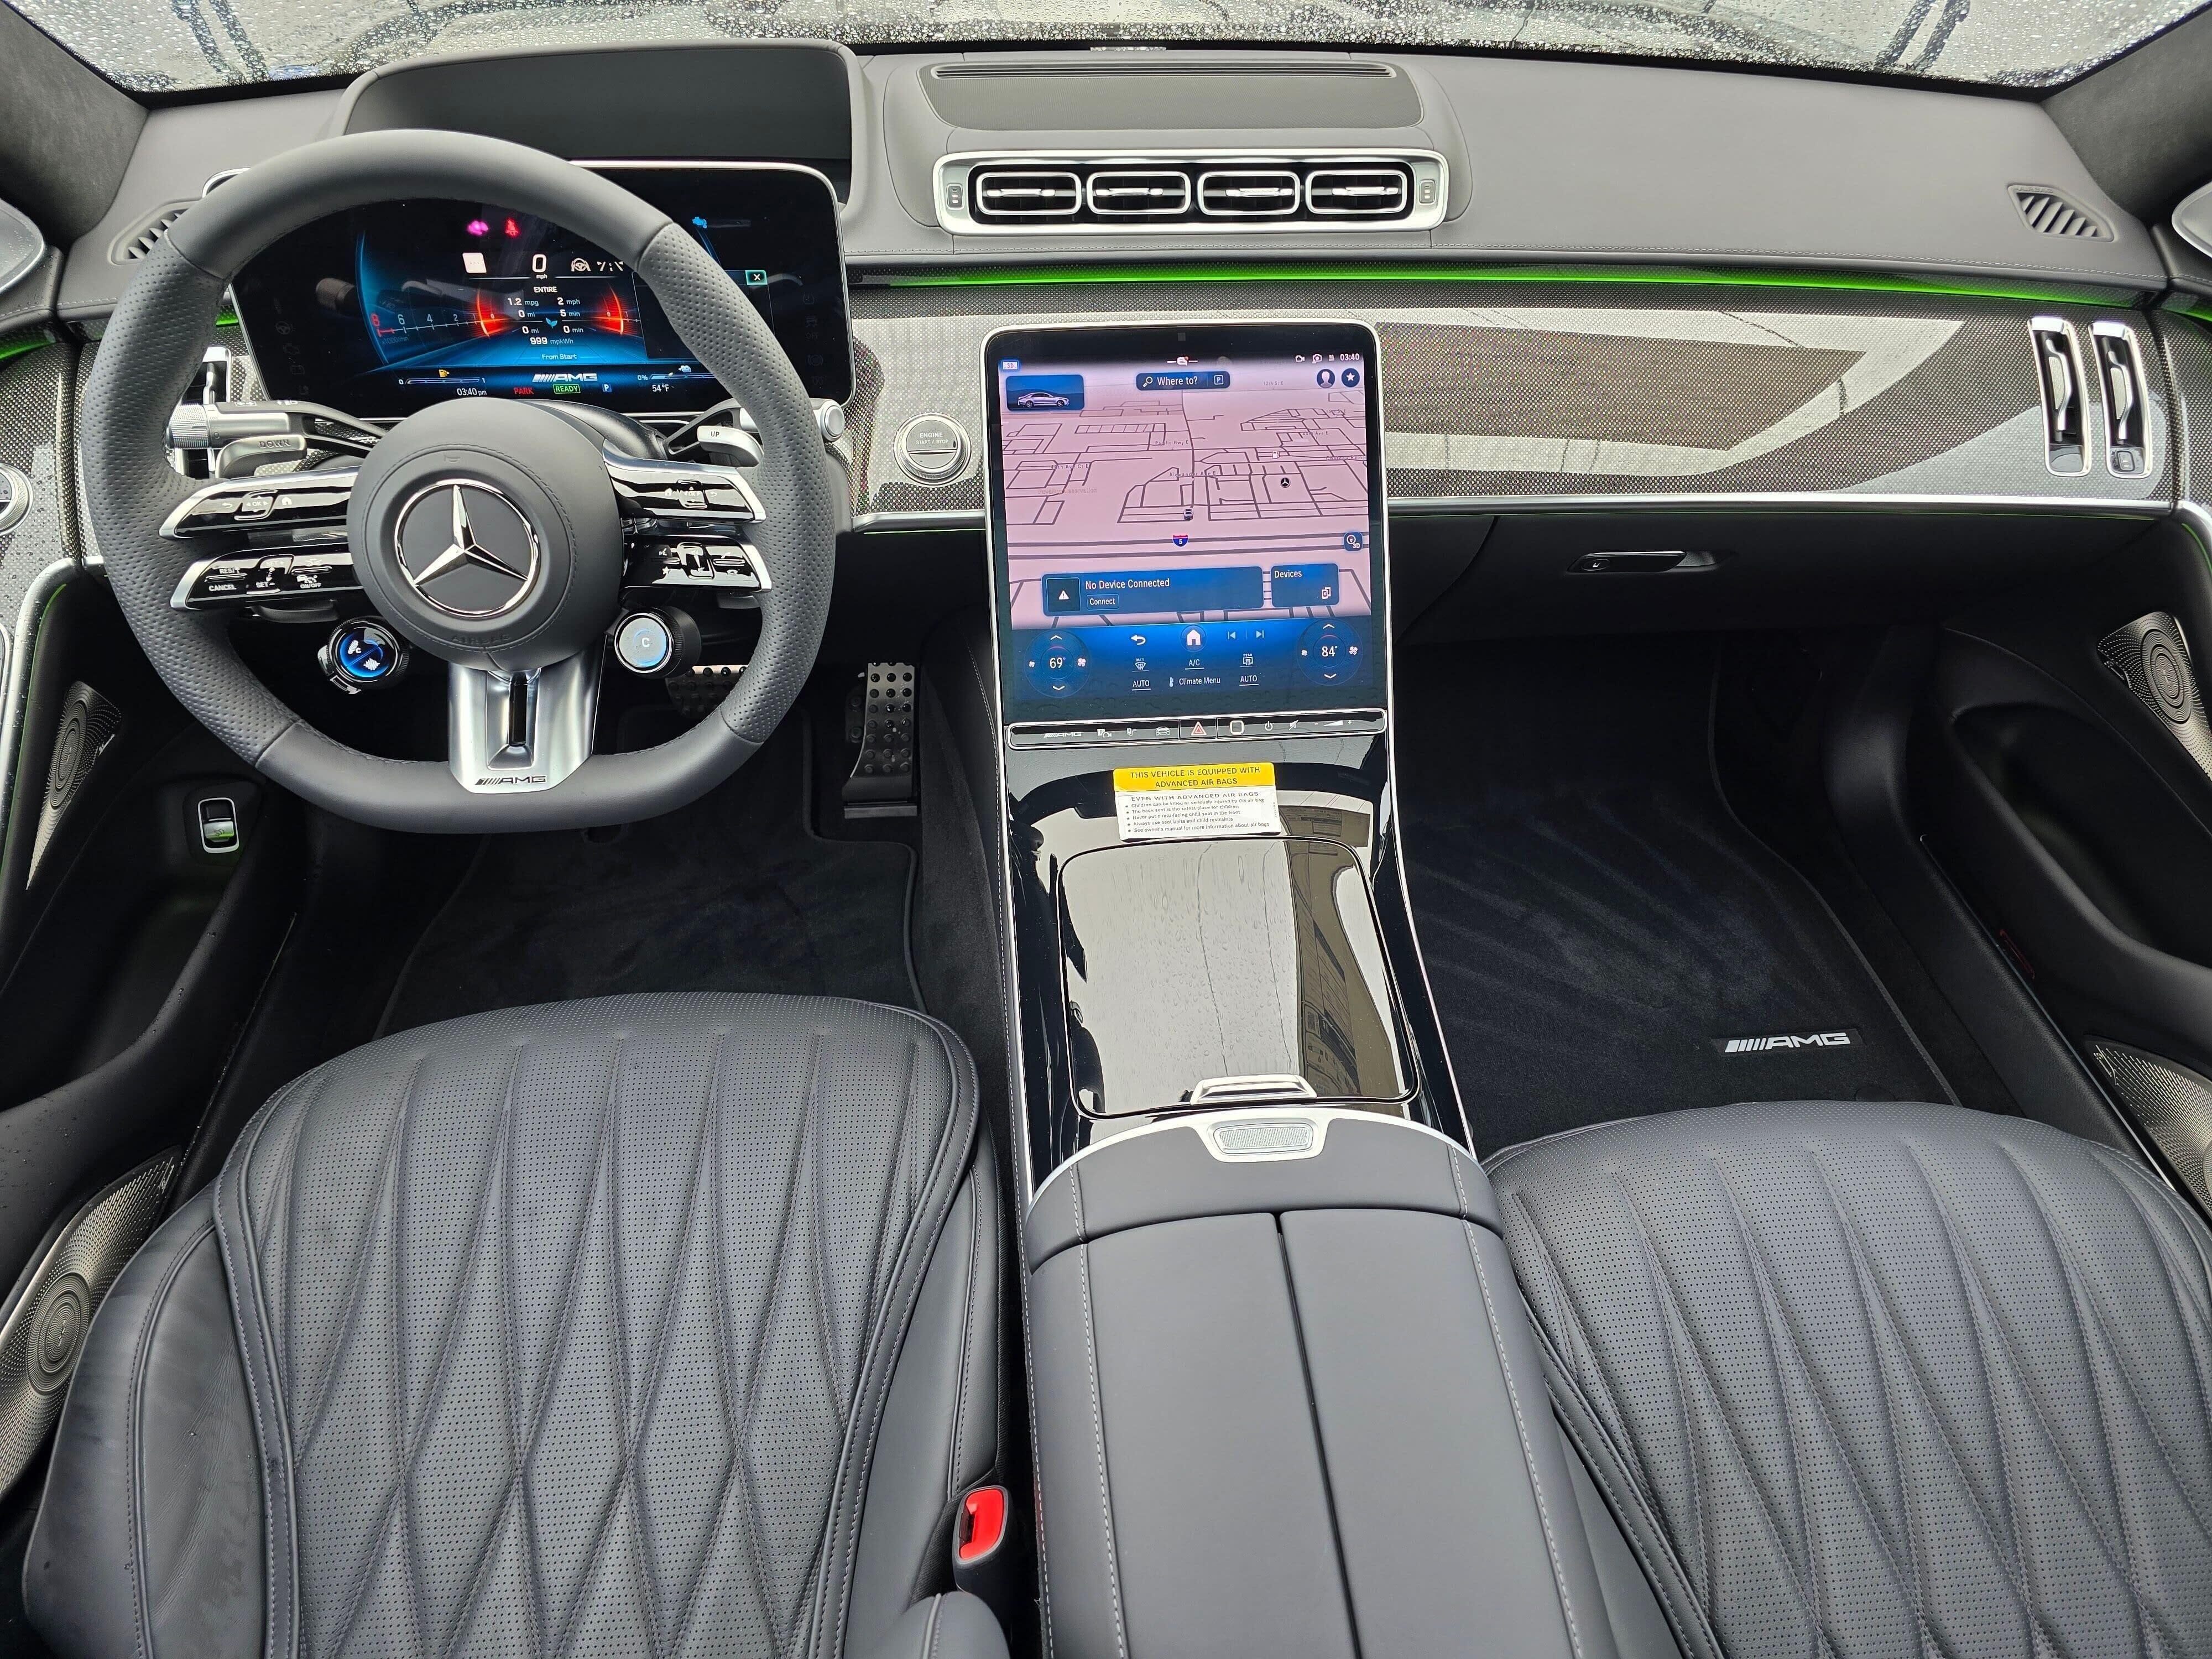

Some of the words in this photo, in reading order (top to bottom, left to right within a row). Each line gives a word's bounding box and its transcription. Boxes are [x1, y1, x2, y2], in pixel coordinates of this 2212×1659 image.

[533, 254, 546, 273] 0
[508, 298, 522, 306] 1.2
[557, 297, 564, 305] 2
[398, 314, 405, 325] 6
[427, 314, 433, 322] 4
[563, 325, 570, 333] 0
[1157, 376, 1184, 386] Where
[1186, 375, 1198, 385] to?
[259, 439, 290, 448] DOWN
[1274, 570, 1302, 578] Devices
[1086, 581, 1097, 589] No
[1099, 580, 1126, 589] Device
[1128, 578, 1170, 588] Connected
[1089, 597, 1115, 606] Connect
[641, 638, 650, 647] C
[1188, 659, 1200, 667] A/C
[1240, 675, 1258, 683] AUTO
[1197, 768, 1237, 776] EQUIPPED
